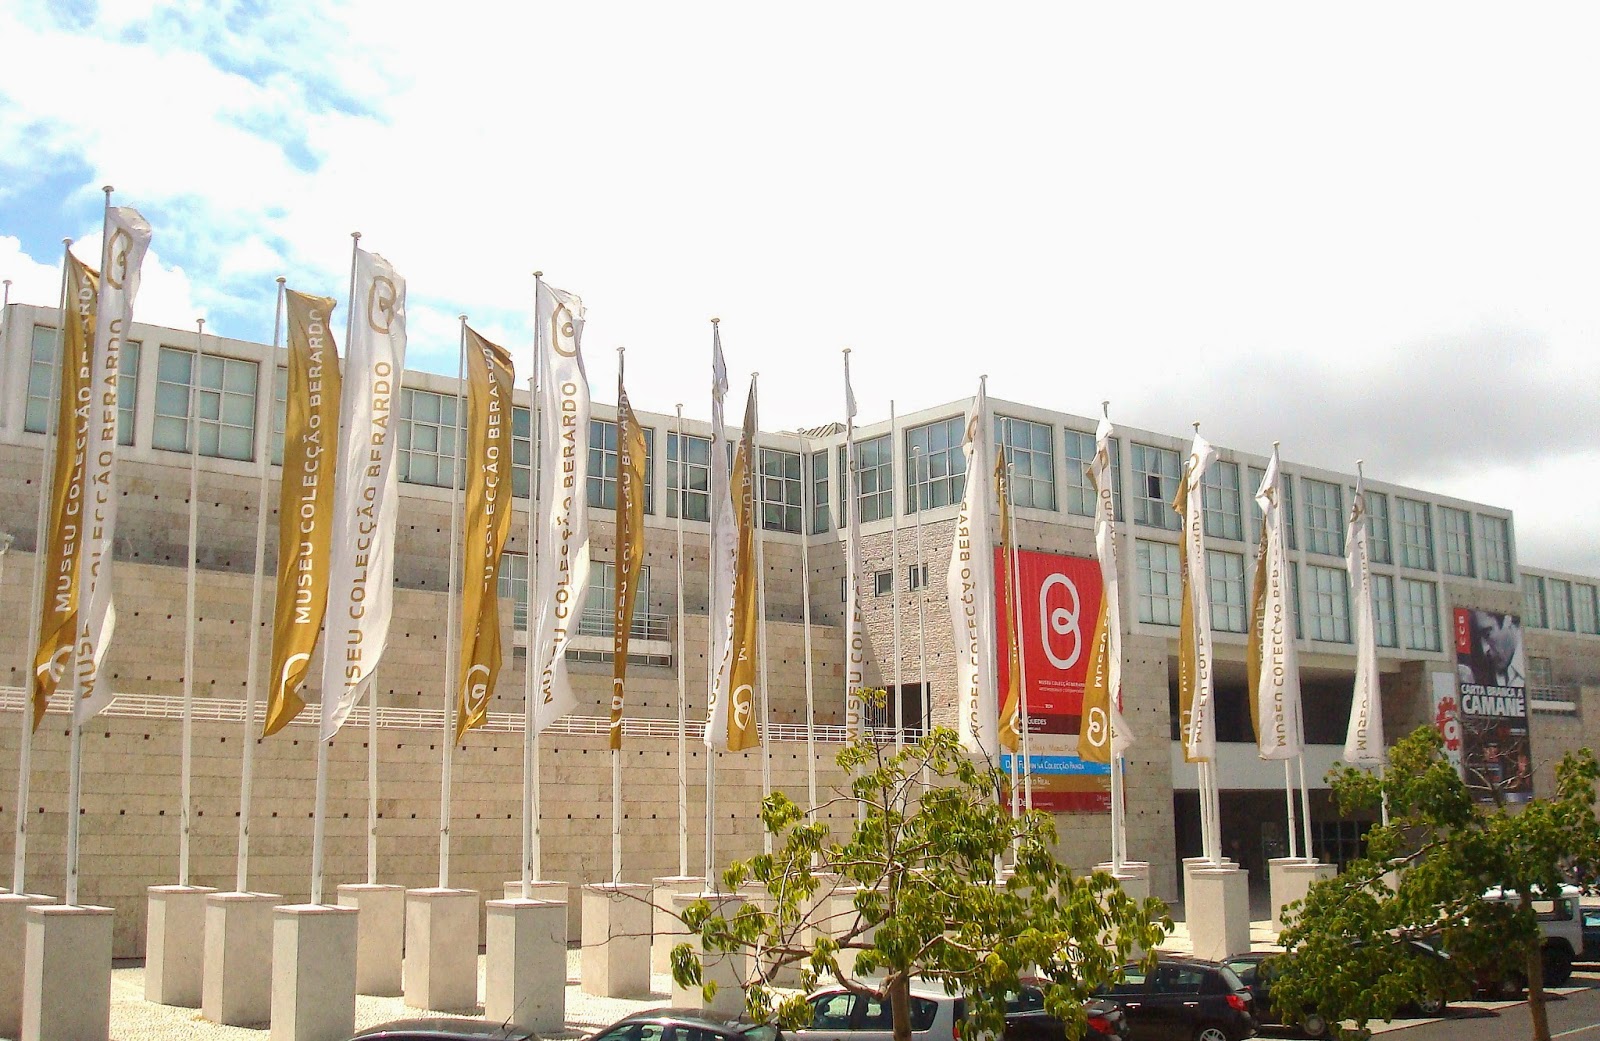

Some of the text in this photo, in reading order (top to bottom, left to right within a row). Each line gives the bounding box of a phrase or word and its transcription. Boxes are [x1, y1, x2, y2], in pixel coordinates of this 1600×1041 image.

[101, 318, 123, 441] BERARDO
[561, 382, 577, 488] BERARDO
[295, 309, 324, 625] MUSEU COLECÇÃO BERARDO
[349, 486, 377, 620] COLECÇÃO
[367, 361, 392, 478] BERARDO
[55, 524, 77, 613] MUSEU
[846, 671, 863, 742] MUSEU
